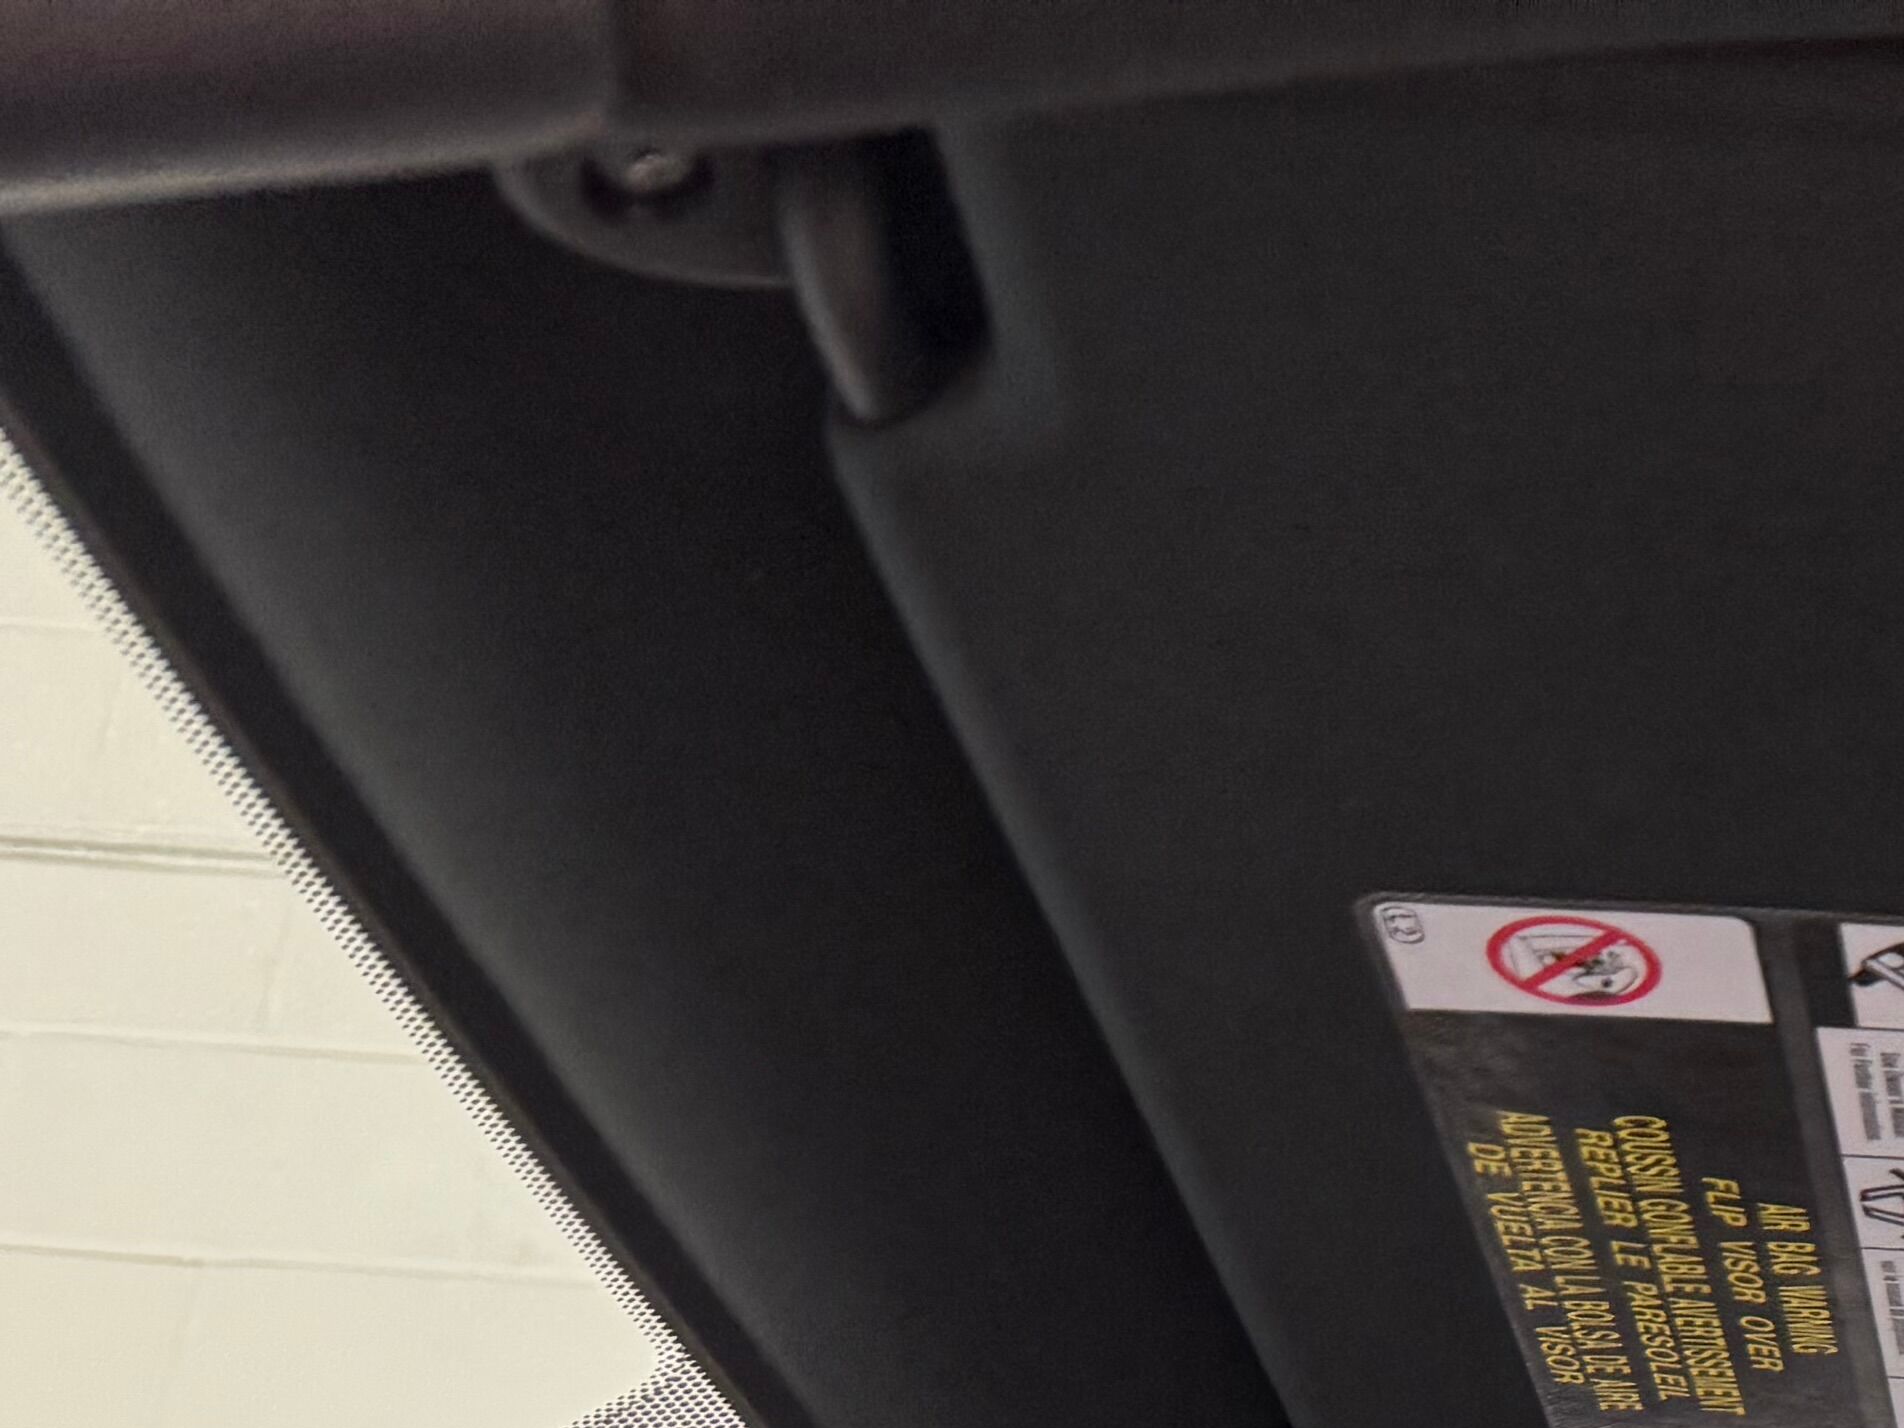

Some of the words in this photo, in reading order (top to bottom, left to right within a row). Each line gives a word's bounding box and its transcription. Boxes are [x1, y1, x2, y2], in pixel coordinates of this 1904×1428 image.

[1468, 1143, 1515, 1177] DE
[1500, 1113, 1582, 1232] ADVERTENCIA
[1577, 1129, 1639, 1228] REPLIER
[1614, 1116, 1683, 1196] COUSSIN
[1702, 1177, 1749, 1228] FLIP
[1758, 1203, 1811, 1232] AIR
[1488, 1193, 1546, 1273] VUELTA
[1540, 1236, 1597, 1272] CON
[1611, 1242, 1653, 1269] LE
[1638, 1198, 1712, 1296] GONFLABLE
[1723, 1242, 1767, 1305] VISOR
[1767, 1243, 1820, 1276] BAG
[1520, 1283, 1557, 1310] AL
[1555, 1276, 1606, 1297] LA
[1564, 1300, 1622, 1351] BOLSA
[1624, 1280, 1690, 1401] PARESOLEIL
[1741, 1317, 1784, 1371] OVER
[1781, 1286, 1836, 1354] WARNING
[1537, 1328, 1585, 1384] VISOR
[1584, 1356, 1632, 1375] DE
[1672, 1299, 1746, 1416] AVERTISSEMENT
[1591, 1379, 1643, 1411] AIRE
